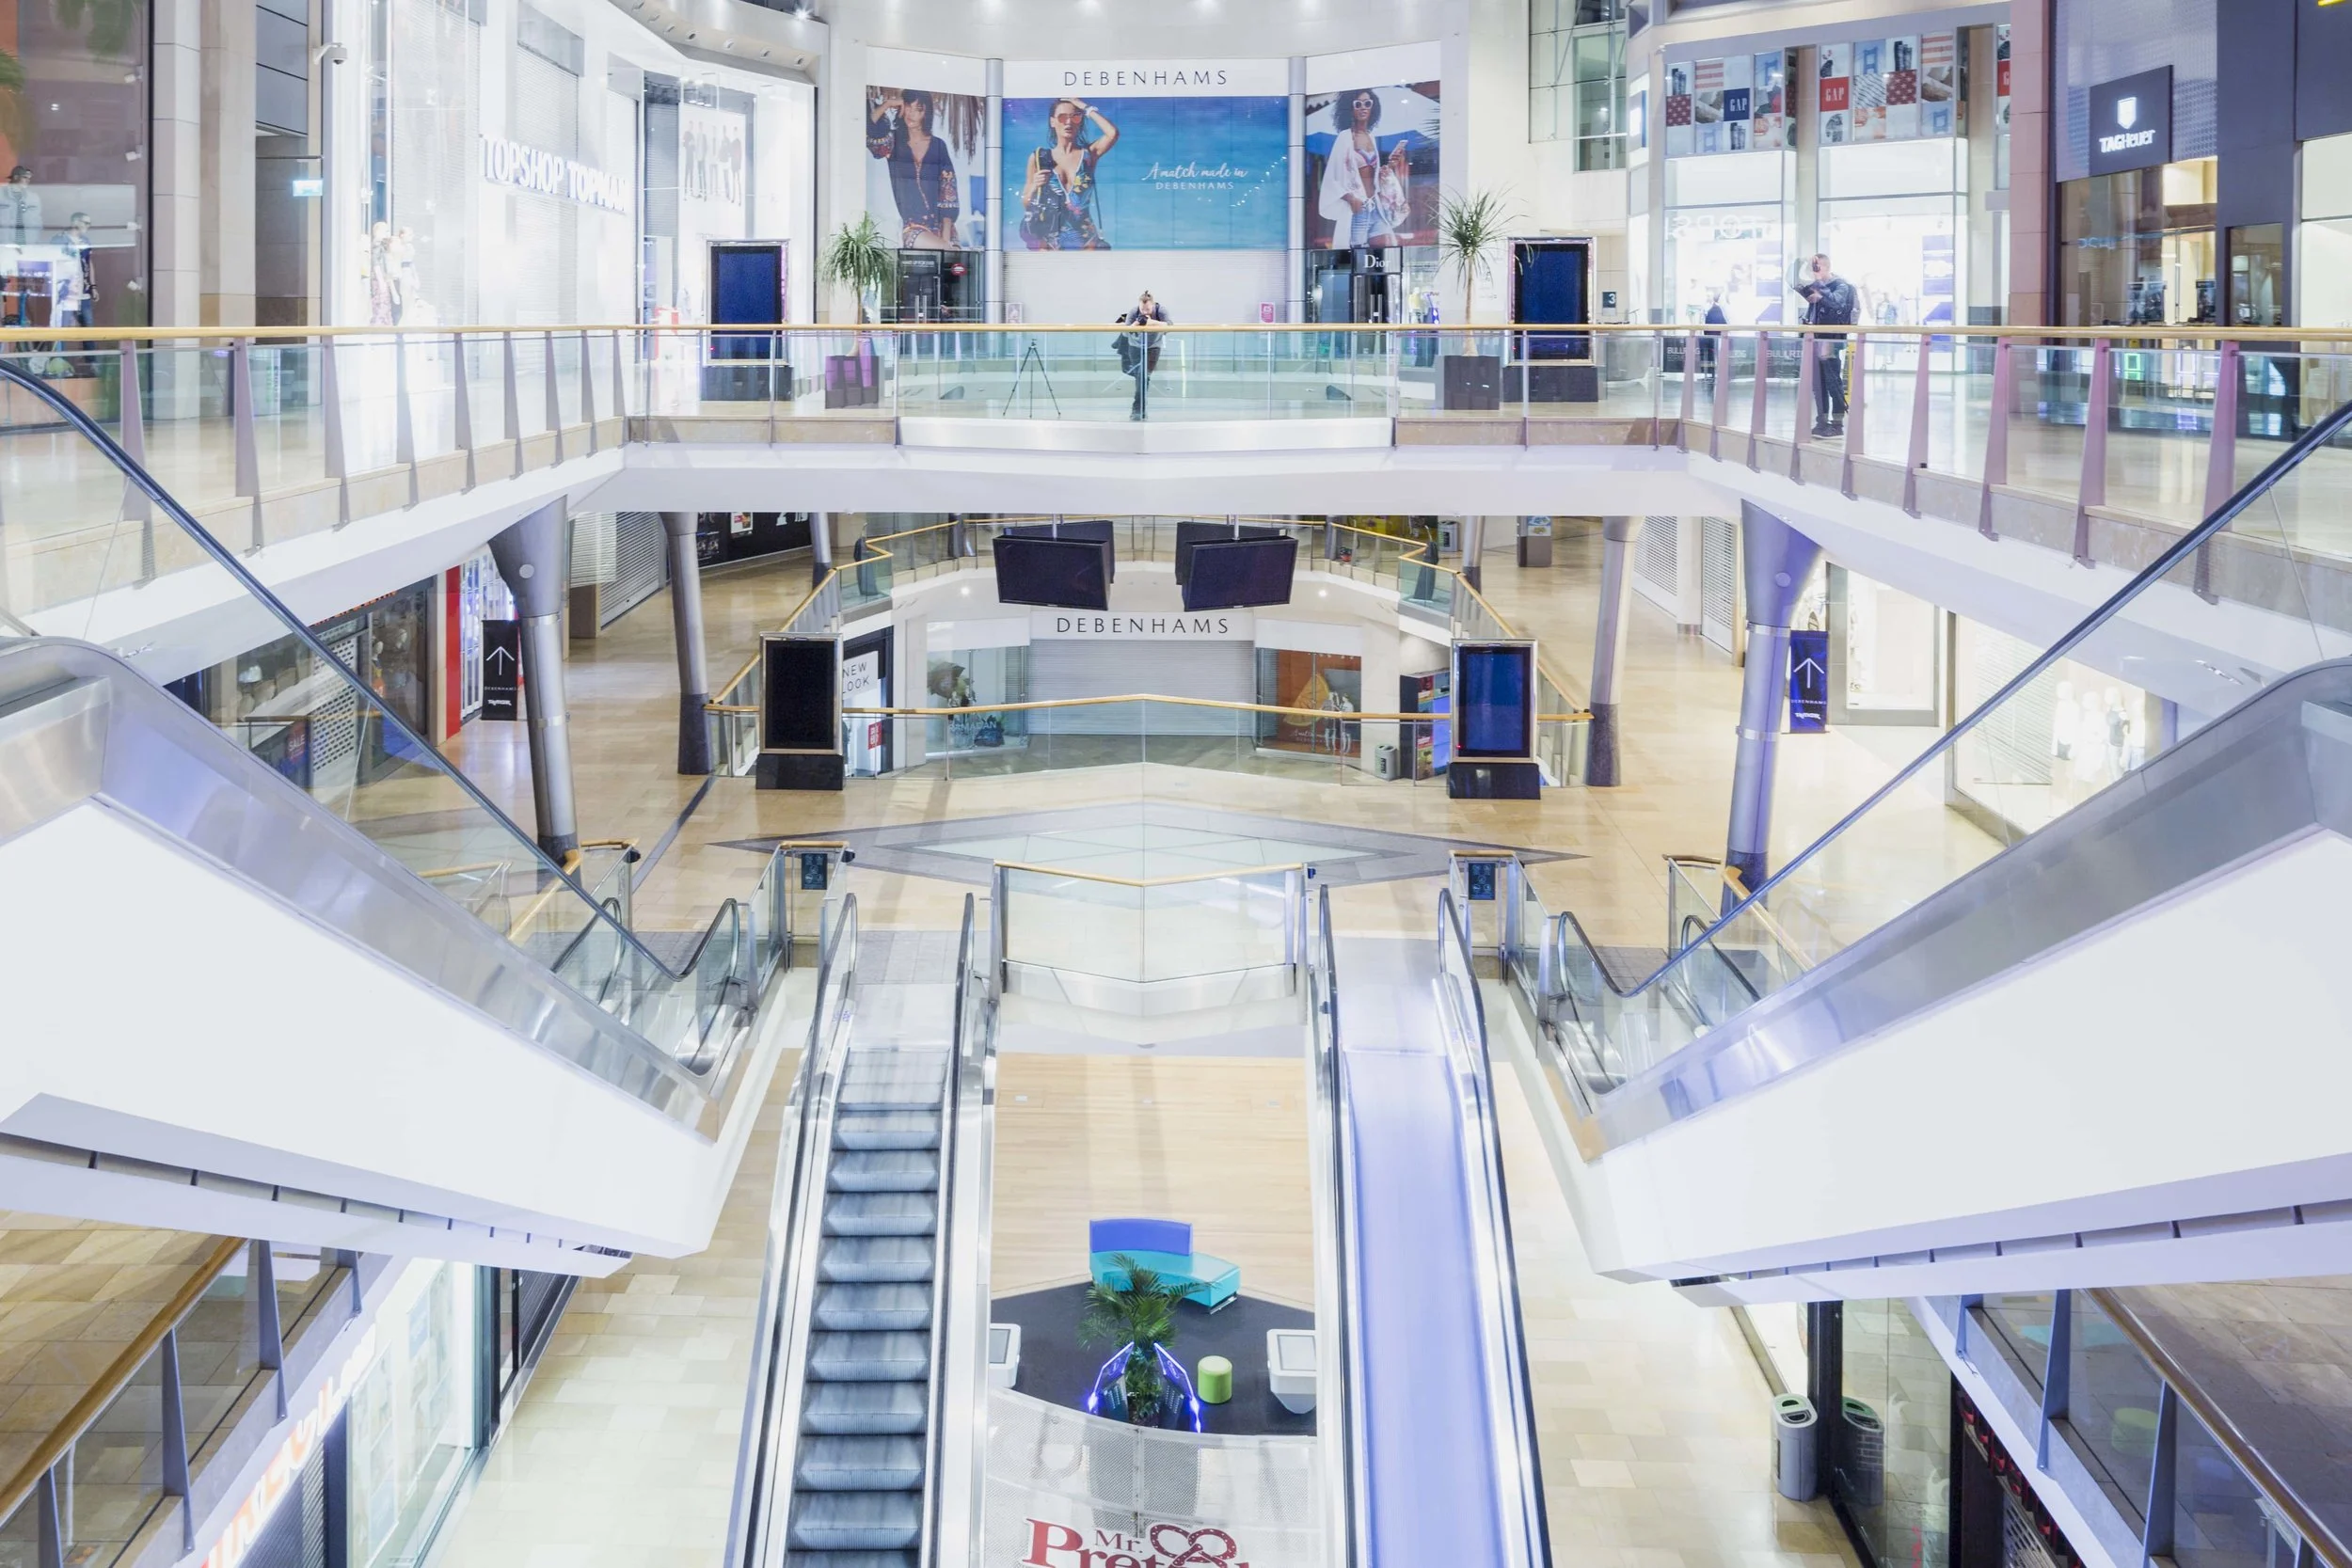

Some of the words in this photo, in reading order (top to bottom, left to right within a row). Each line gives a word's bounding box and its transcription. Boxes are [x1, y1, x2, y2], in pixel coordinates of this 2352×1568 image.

[1064, 70, 1228, 87] DEBENHAMS
[1825, 87, 1845, 102] GAP
[1729, 97, 1748, 112] GAP
[479, 134, 564, 194] TOPSHOP
[566, 160, 628, 213] TOPMAN
[1141, 162, 1160, 181] A
[1160, 162, 1199, 179] match
[1200, 163, 1231, 179] made
[1233, 167, 1248, 179] in
[1155, 182, 1235, 190] DEBENHAMS
[1364, 254, 1391, 269] Dior
[1608, 293, 1616, 305] 3
[1057, 617, 1229, 634] DEBENHAMS
[843, 662, 866, 677] NEW
[1095, 1529, 1143, 1554] Mr.
